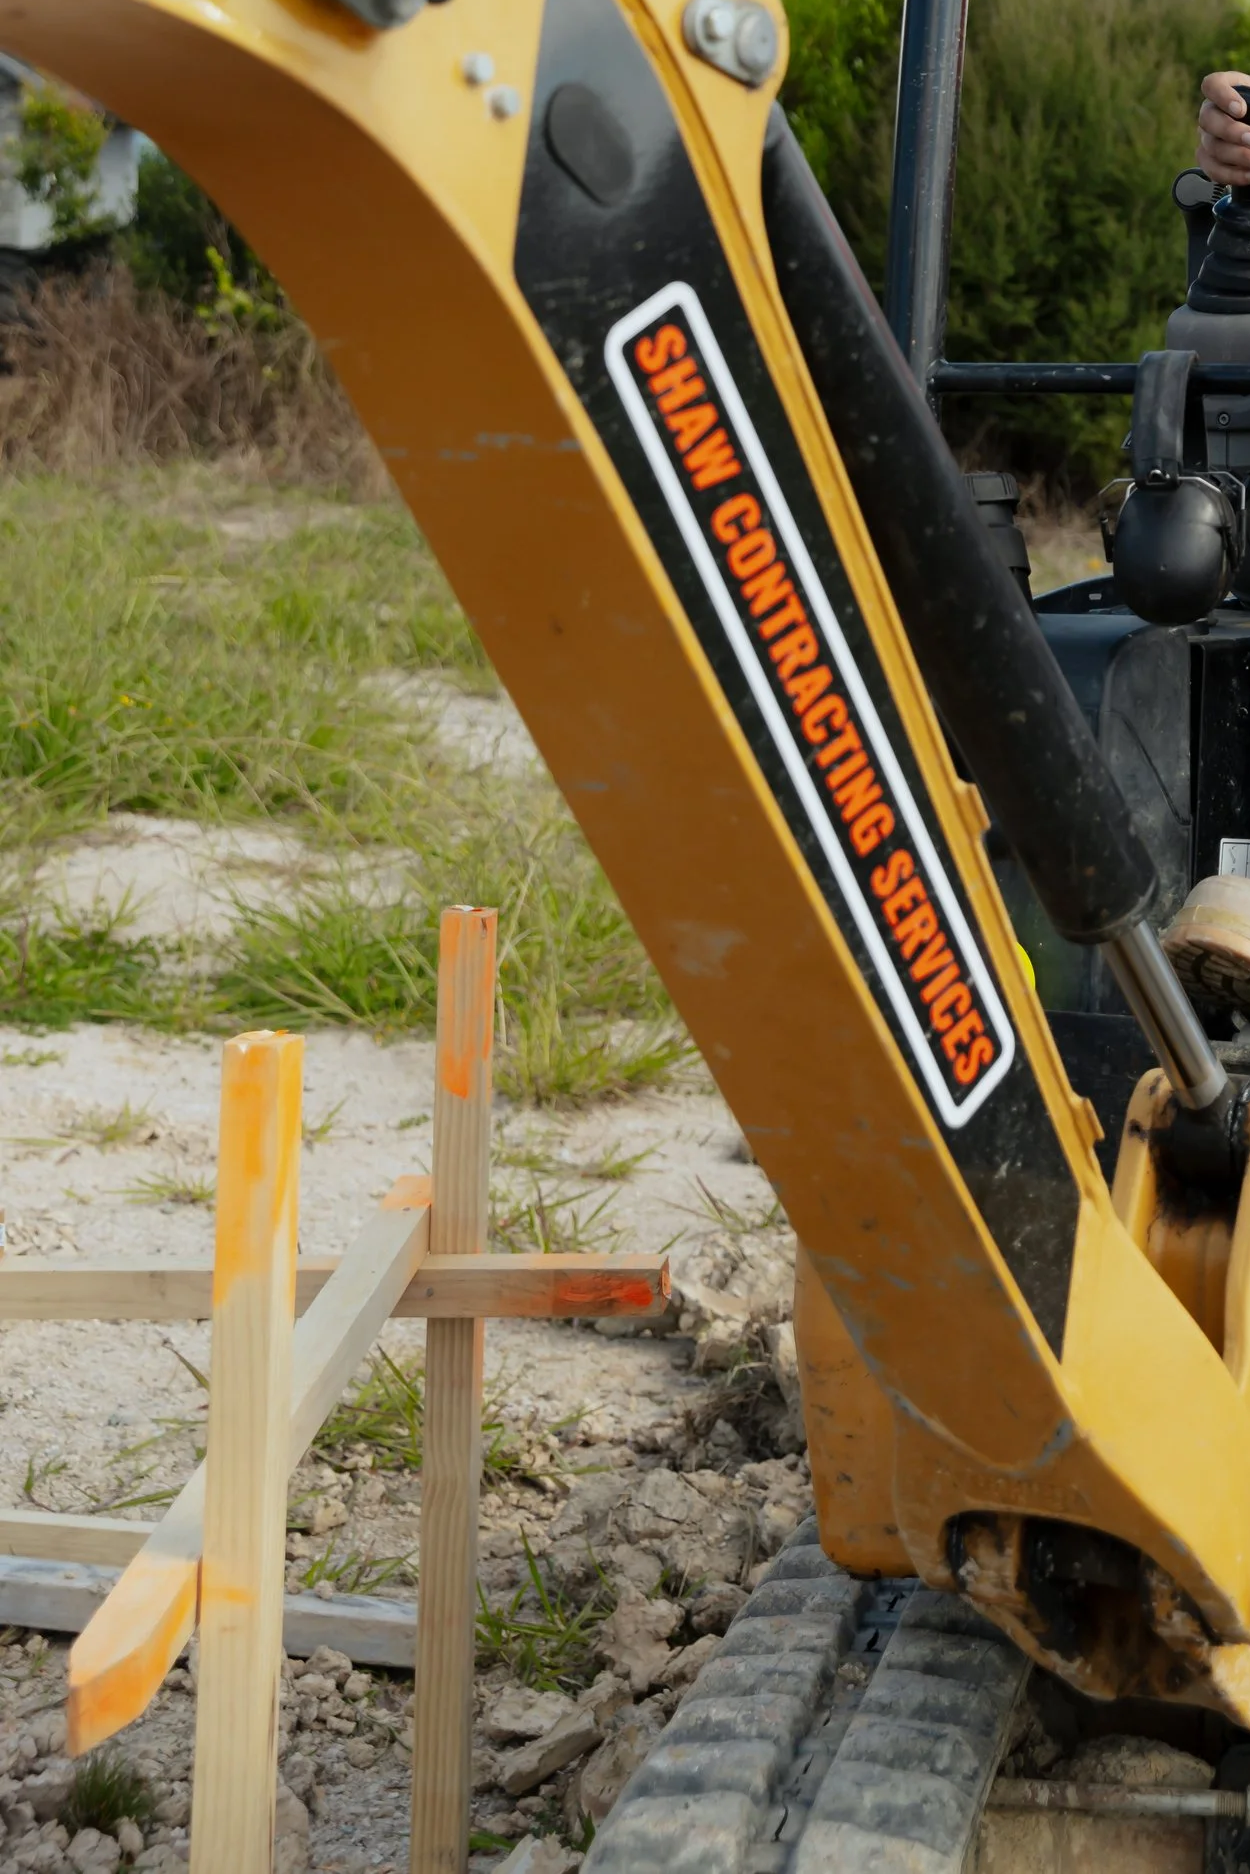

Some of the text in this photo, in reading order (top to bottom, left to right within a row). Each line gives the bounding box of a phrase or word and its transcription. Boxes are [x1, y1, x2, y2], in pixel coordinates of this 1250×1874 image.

[633, 323, 997, 1088] SHAW CONTRACTING SERVICES
